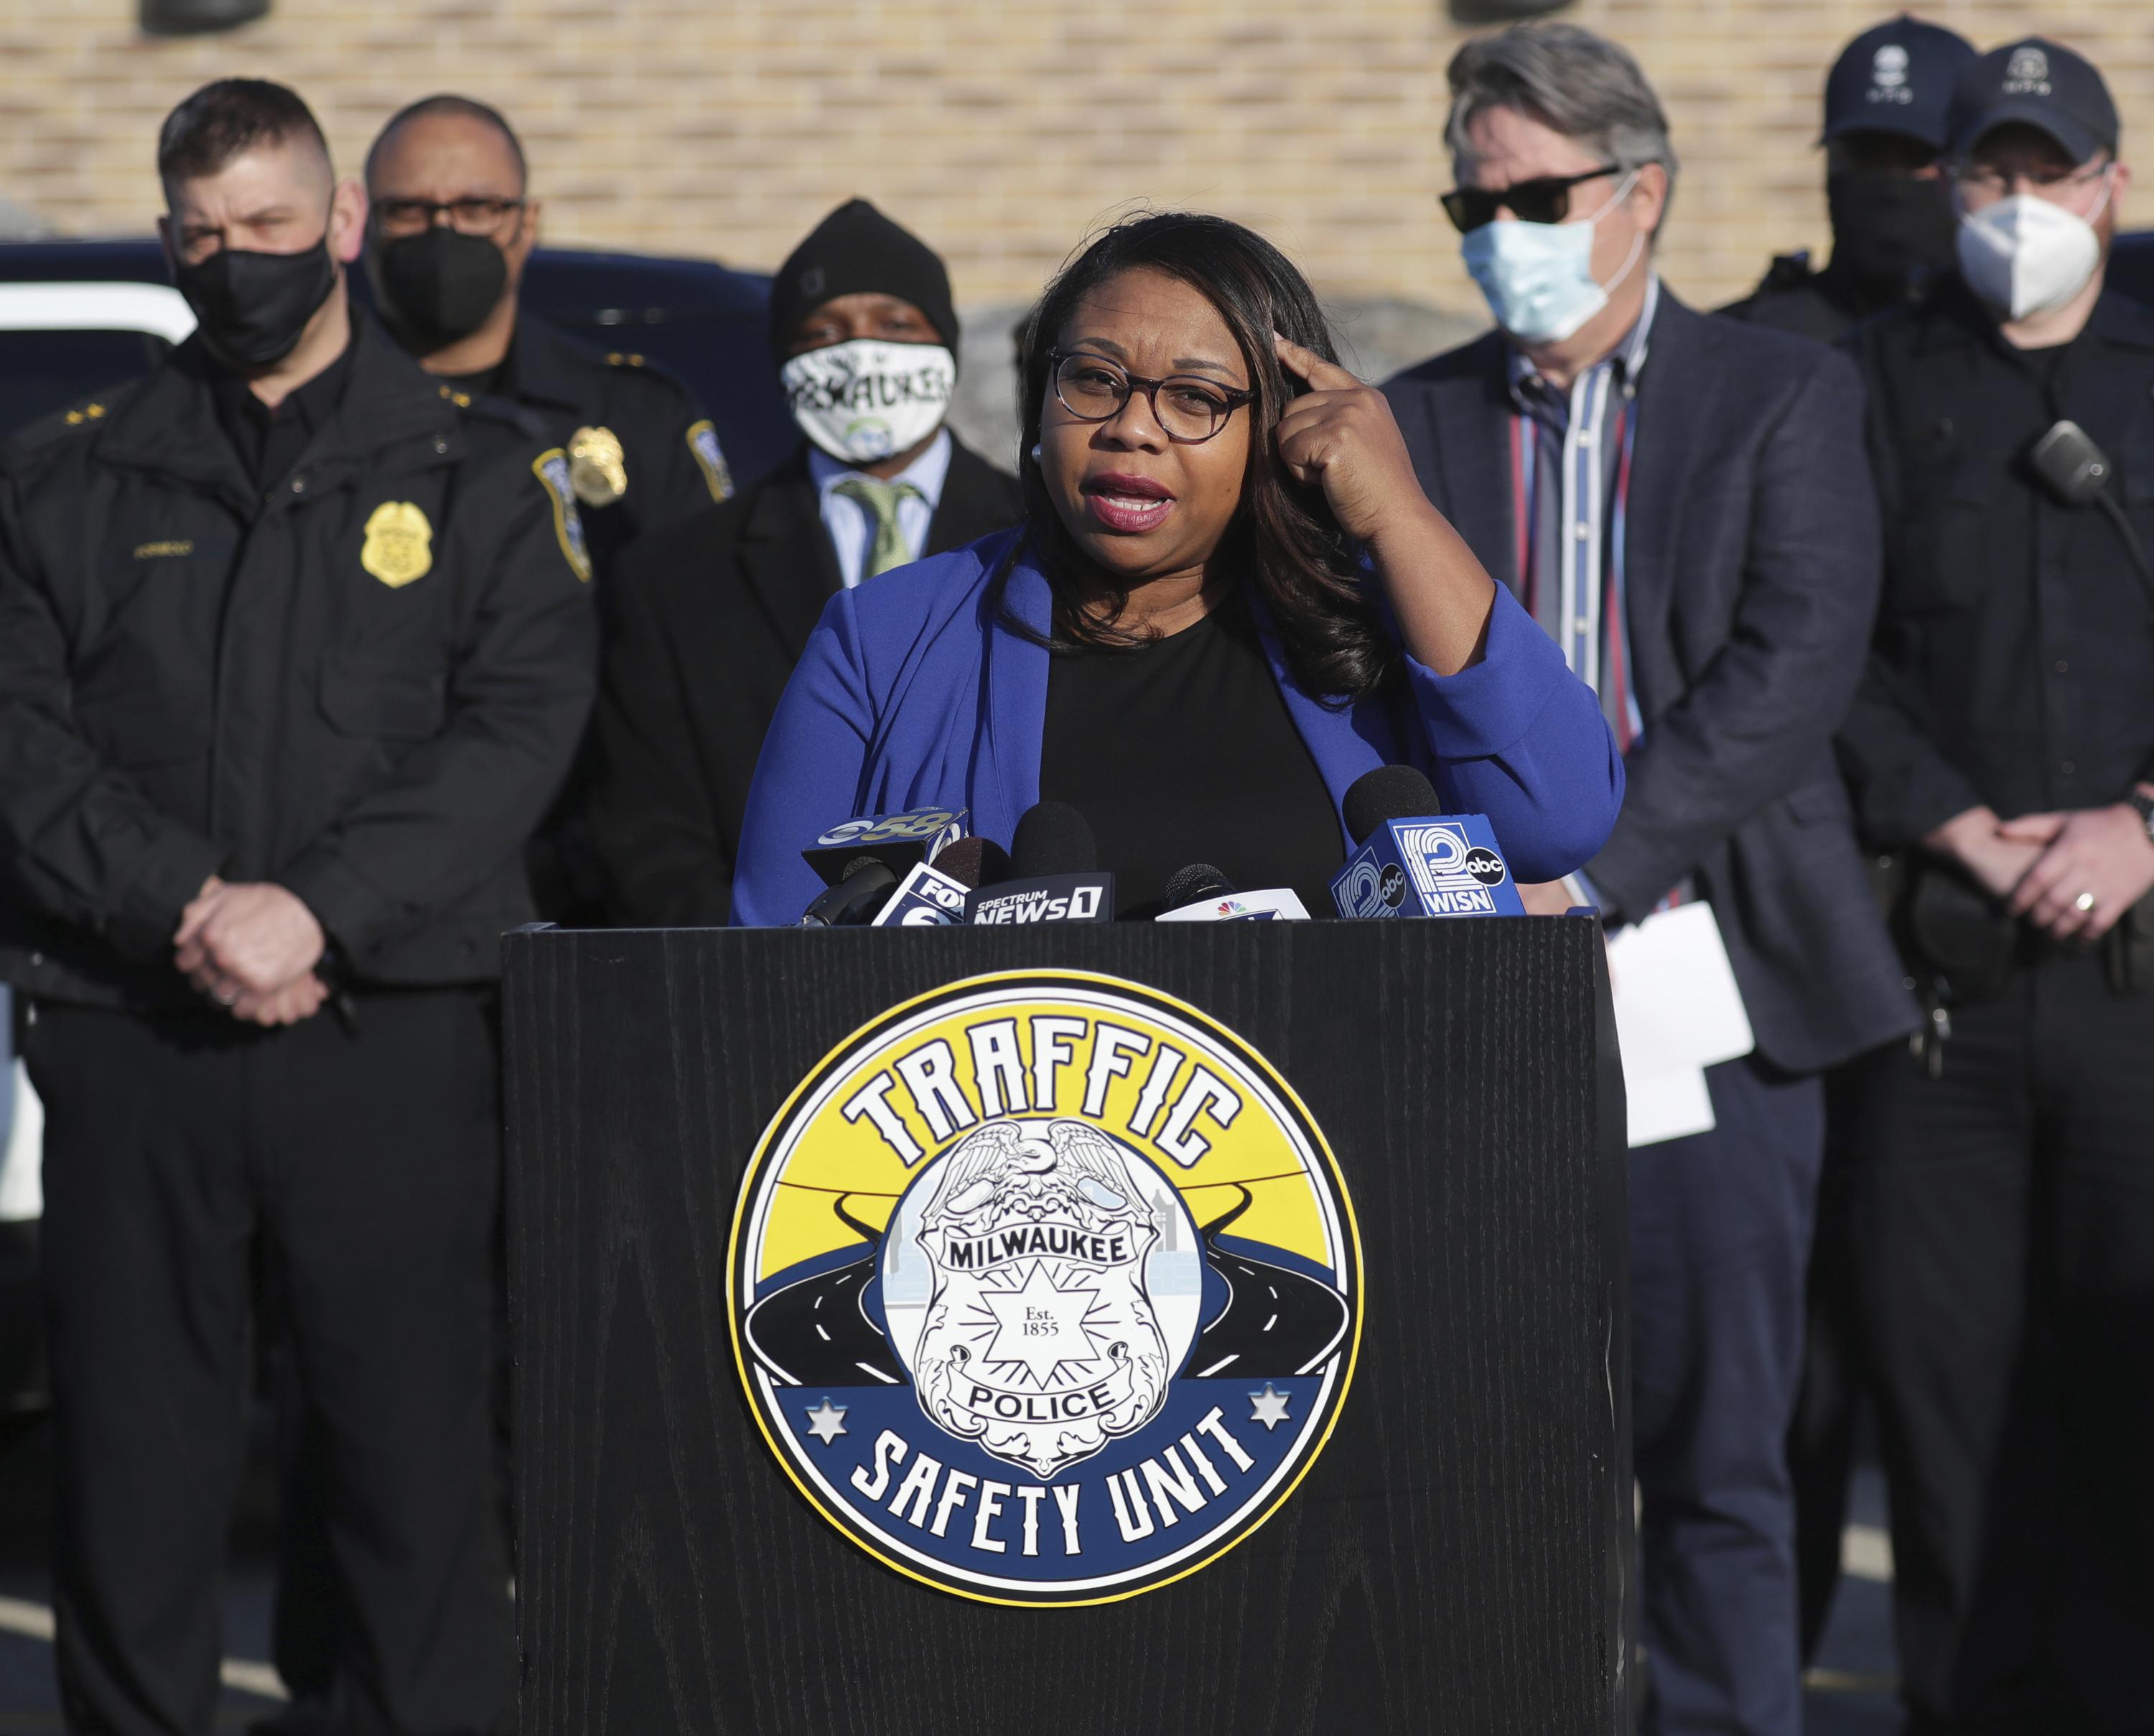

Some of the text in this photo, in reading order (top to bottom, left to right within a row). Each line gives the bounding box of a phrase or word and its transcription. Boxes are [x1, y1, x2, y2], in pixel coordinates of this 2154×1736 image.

[860, 812, 954, 841] 58
[1465, 857, 1503, 874] abc
[1381, 871, 1404, 900] abc
[976, 890, 1048, 913] SPECTRUM
[1423, 890, 1492, 913] WISN
[843, 1017, 1242, 1169] TRAFFIC
[950, 1226, 1128, 1269] MILWAUKEE
[1025, 1306, 1054, 1320] Est.
[1022, 1322, 1059, 1336] 1855
[968, 1382, 1116, 1420] POLICE
[851, 1406, 1257, 1557] SAFETY UNIT
